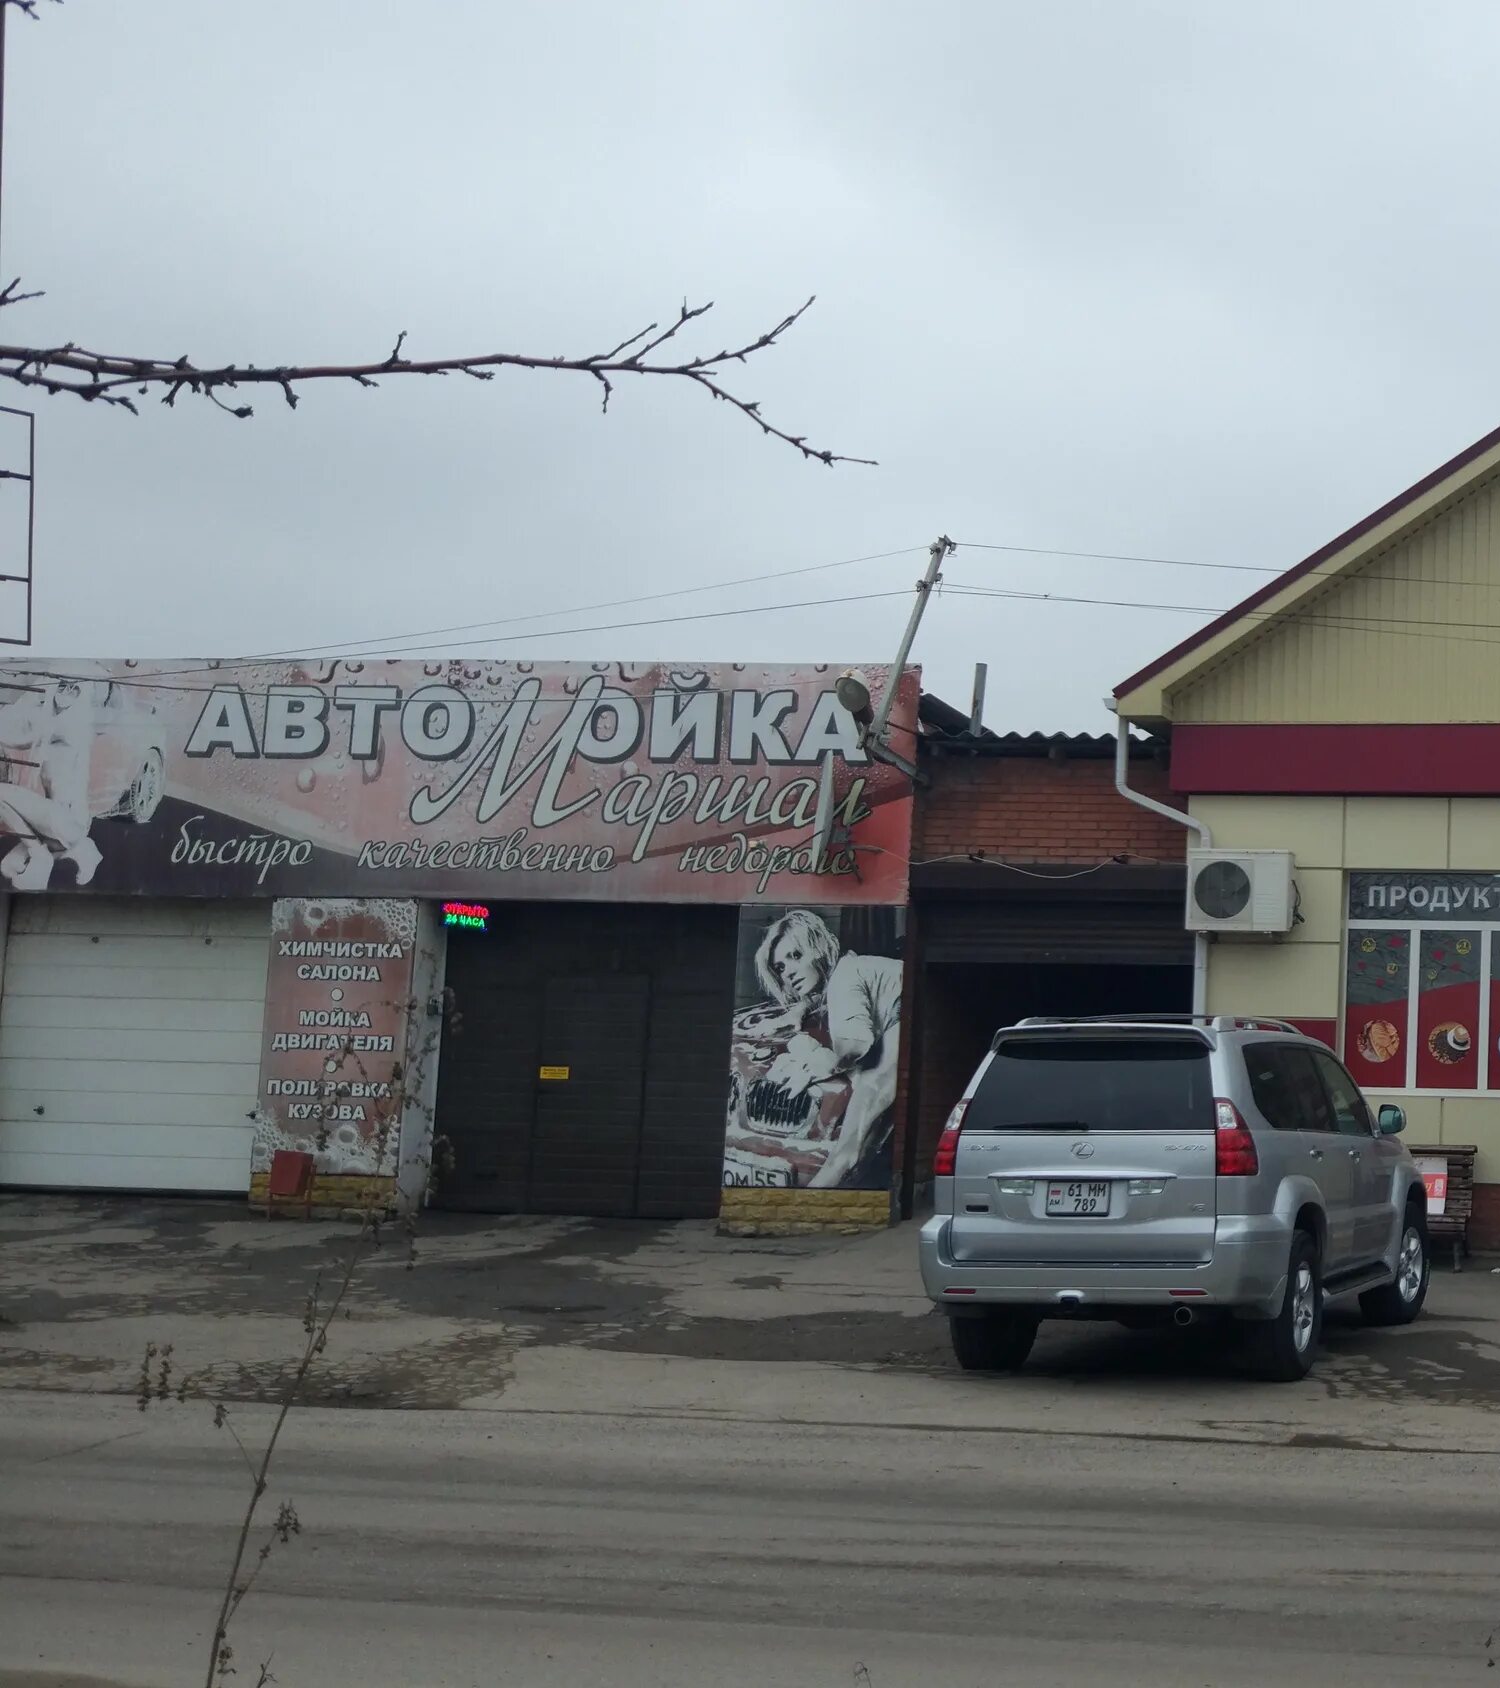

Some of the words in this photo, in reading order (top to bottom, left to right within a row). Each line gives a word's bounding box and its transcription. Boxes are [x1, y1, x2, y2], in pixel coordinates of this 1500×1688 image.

[171, 815, 314, 884] быстро
[358, 828, 617, 873] качественно
[678, 832, 856, 894] недорого
[443, 903, 489, 918] ОТКРЫТО
[278, 940, 403, 959] ХИМЧИСТКА
[296, 964, 381, 982] САЛОНА
[298, 1008, 371, 1028] МОЙКА
[271, 1033, 394, 1051] ДВИГАТЕЛЯ
[1068, 1184, 1082, 1197] 61
[1074, 1198, 1097, 1212] 789
